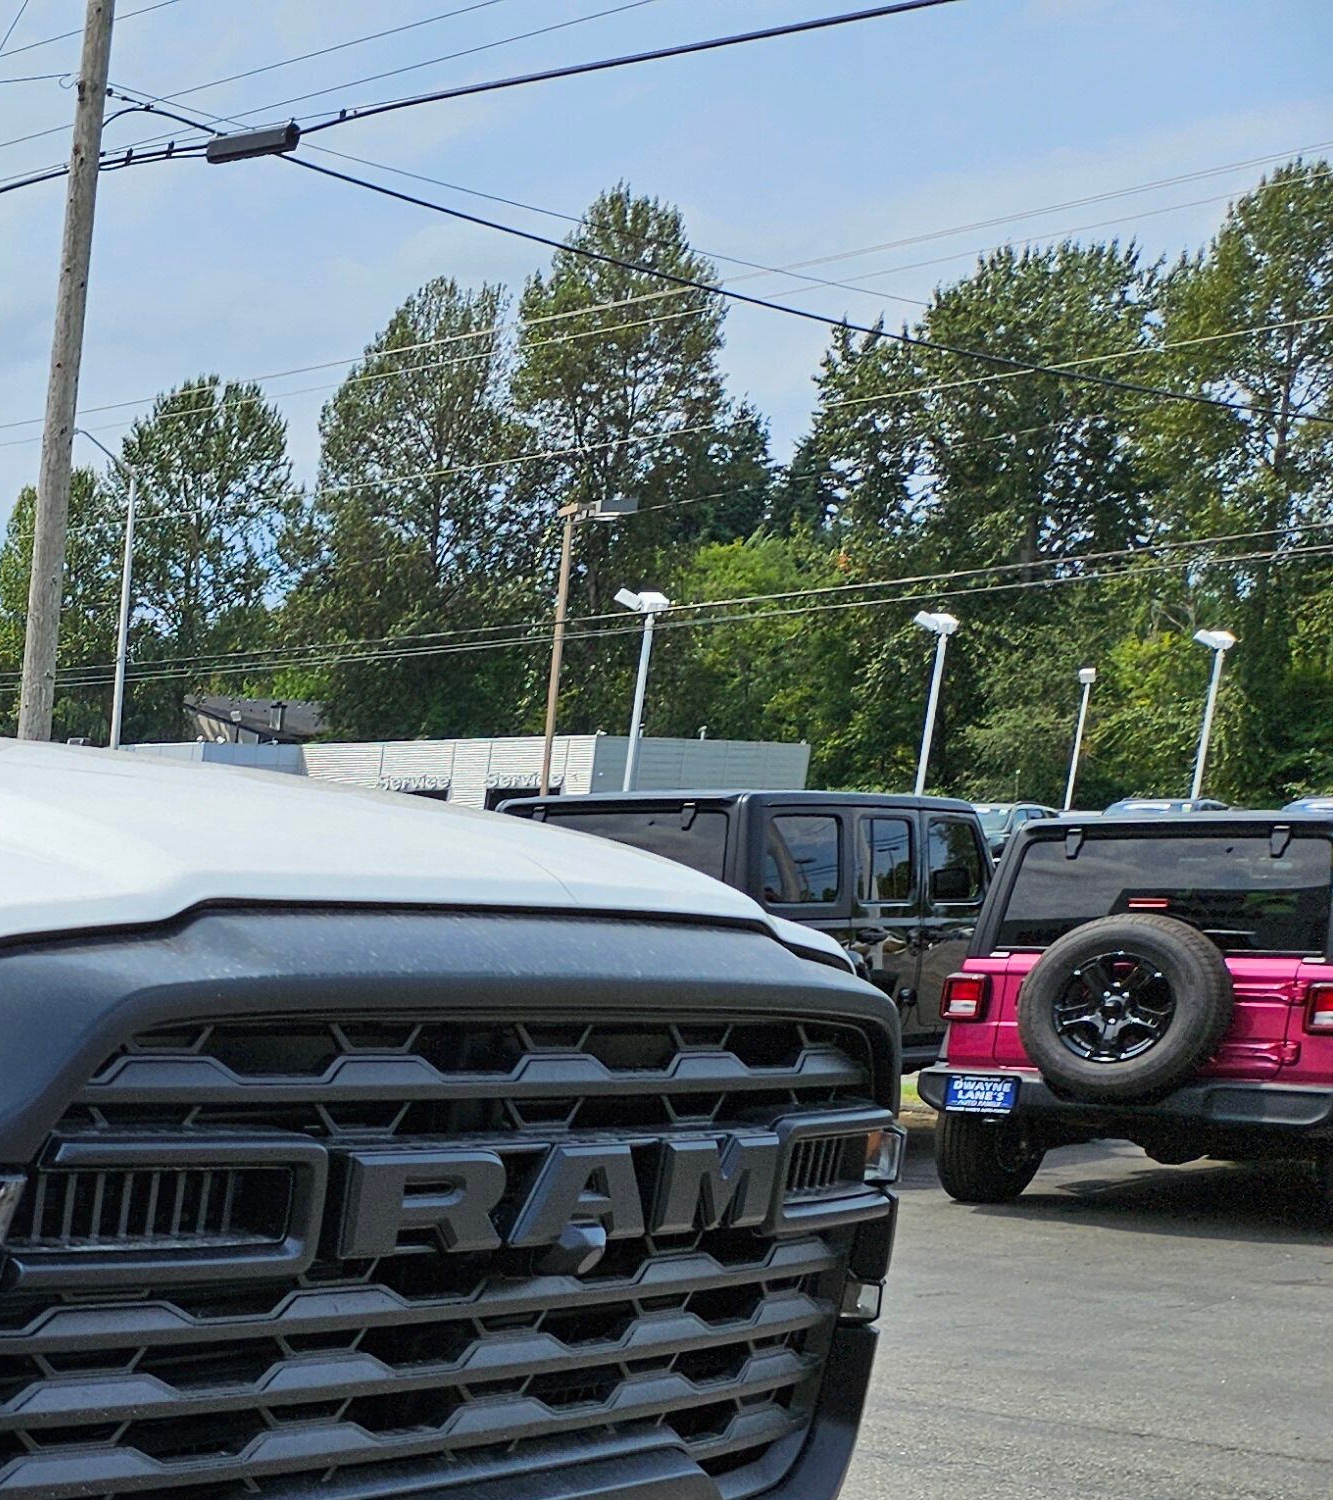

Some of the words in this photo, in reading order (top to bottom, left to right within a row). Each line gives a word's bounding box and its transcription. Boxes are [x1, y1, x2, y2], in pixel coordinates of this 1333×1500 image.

[953, 1080, 1012, 1092] DWAYNE
[957, 1090, 1005, 1101] LANE'S
[339, 1131, 780, 1260] RAM
